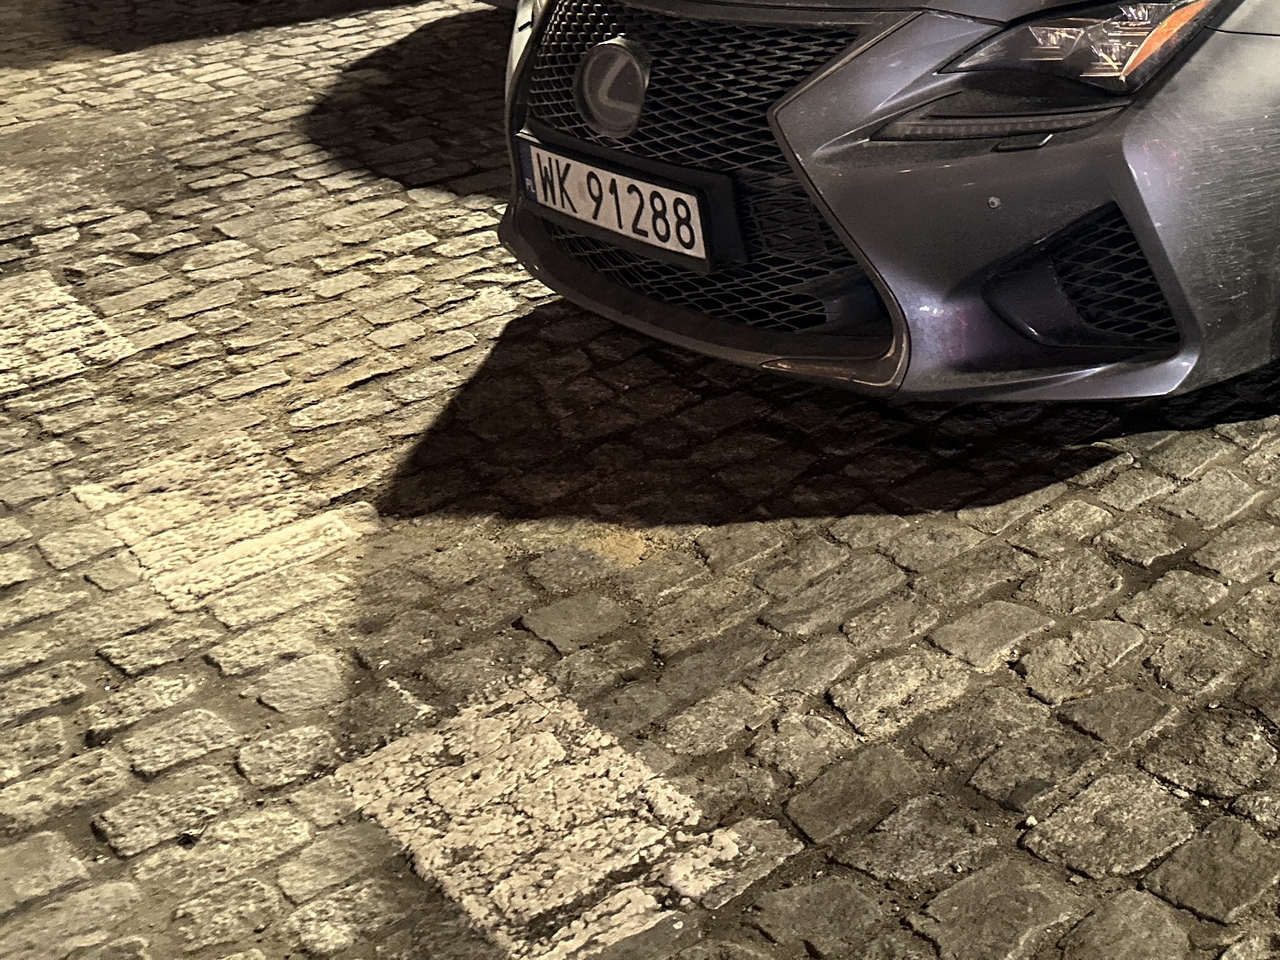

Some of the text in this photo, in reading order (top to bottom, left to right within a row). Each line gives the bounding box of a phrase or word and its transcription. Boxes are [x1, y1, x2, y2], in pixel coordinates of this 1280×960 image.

[525, 177, 536, 193] PL
[536, 152, 696, 250] WK 91288
